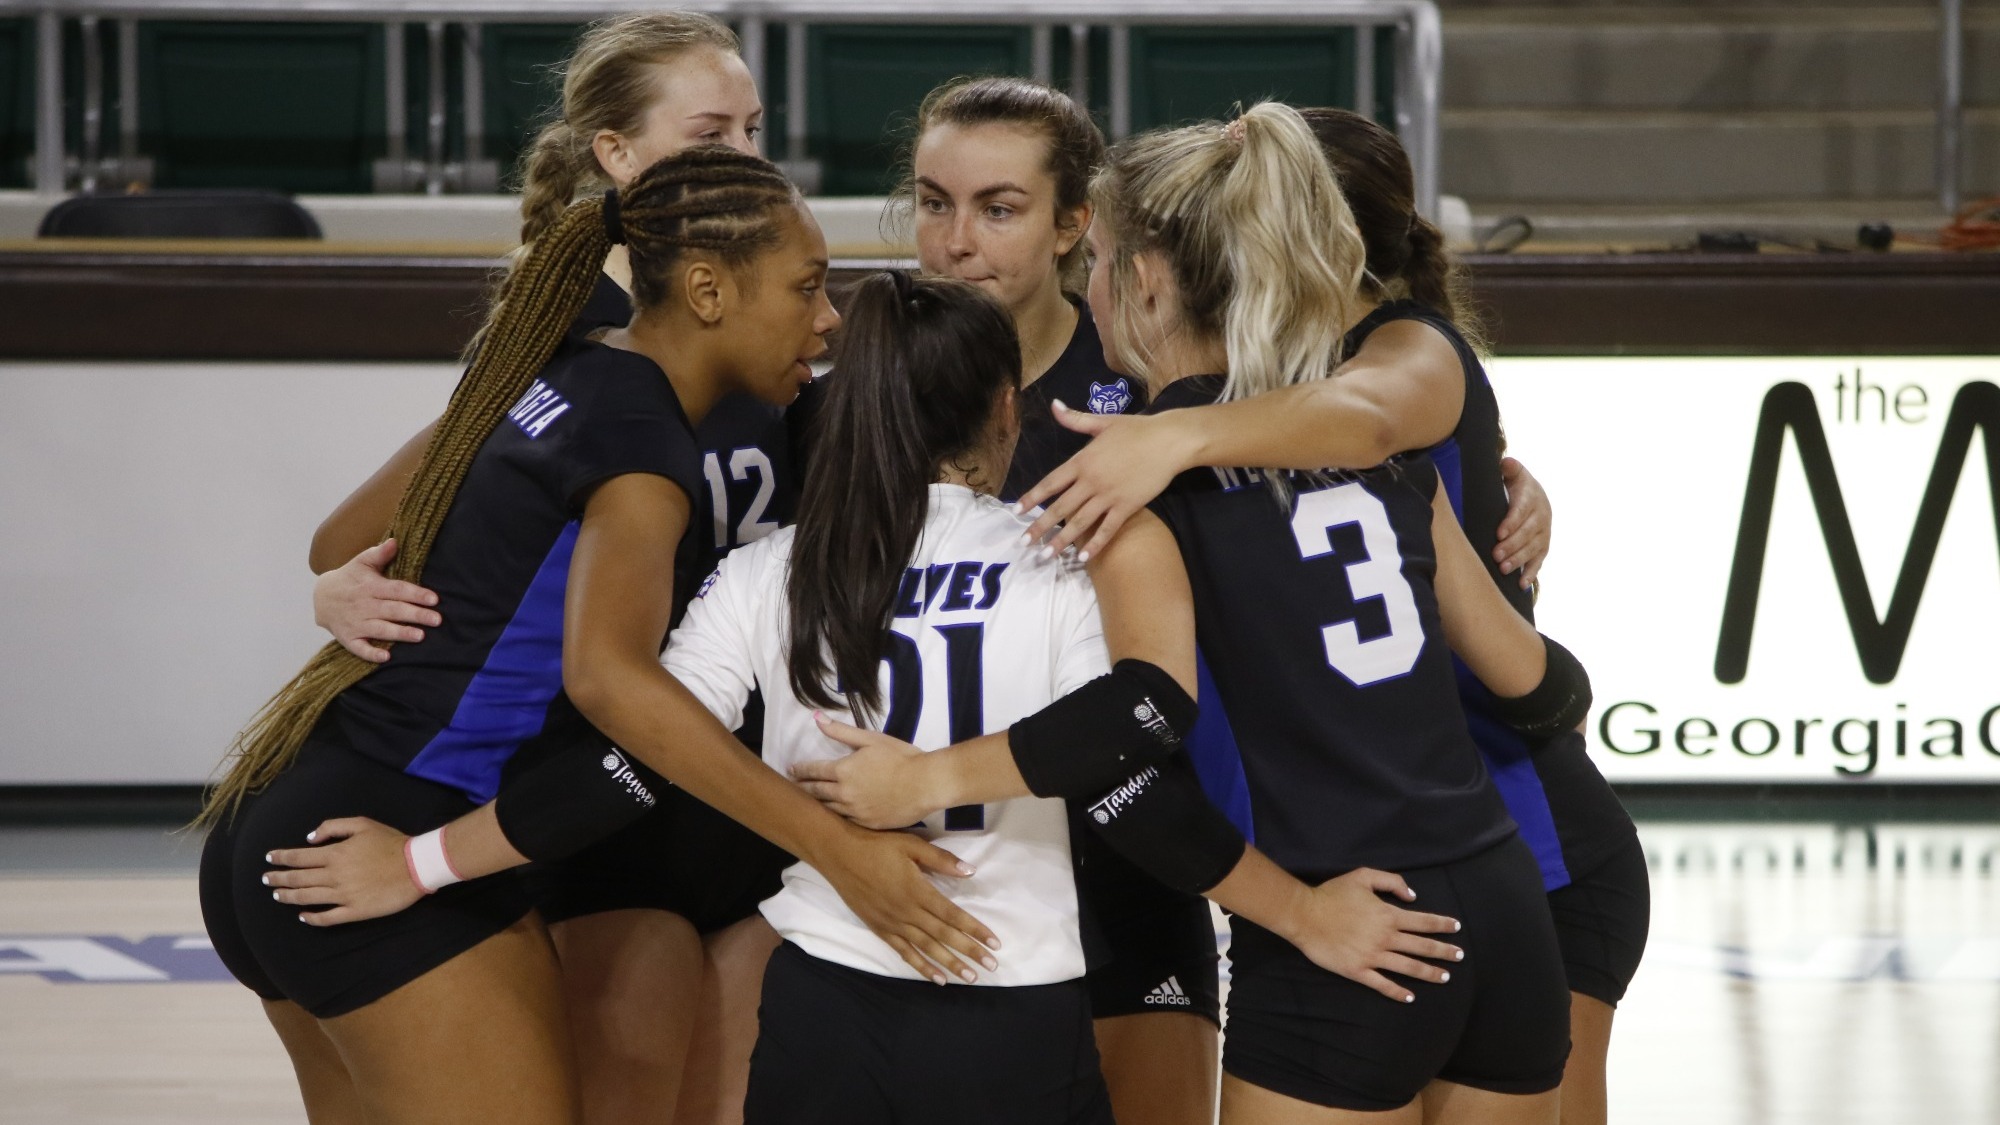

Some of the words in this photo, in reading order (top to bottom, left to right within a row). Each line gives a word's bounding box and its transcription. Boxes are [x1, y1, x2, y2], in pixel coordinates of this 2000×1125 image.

[507, 377, 572, 440] RGIA
[1834, 367, 1928, 424] the
[702, 445, 779, 549] 12
[894, 560, 1010, 618] LVES
[1290, 479, 1426, 689] 3
[1088, 766, 1159, 818] Tandem
[1144, 993, 1191, 1005] adidas
